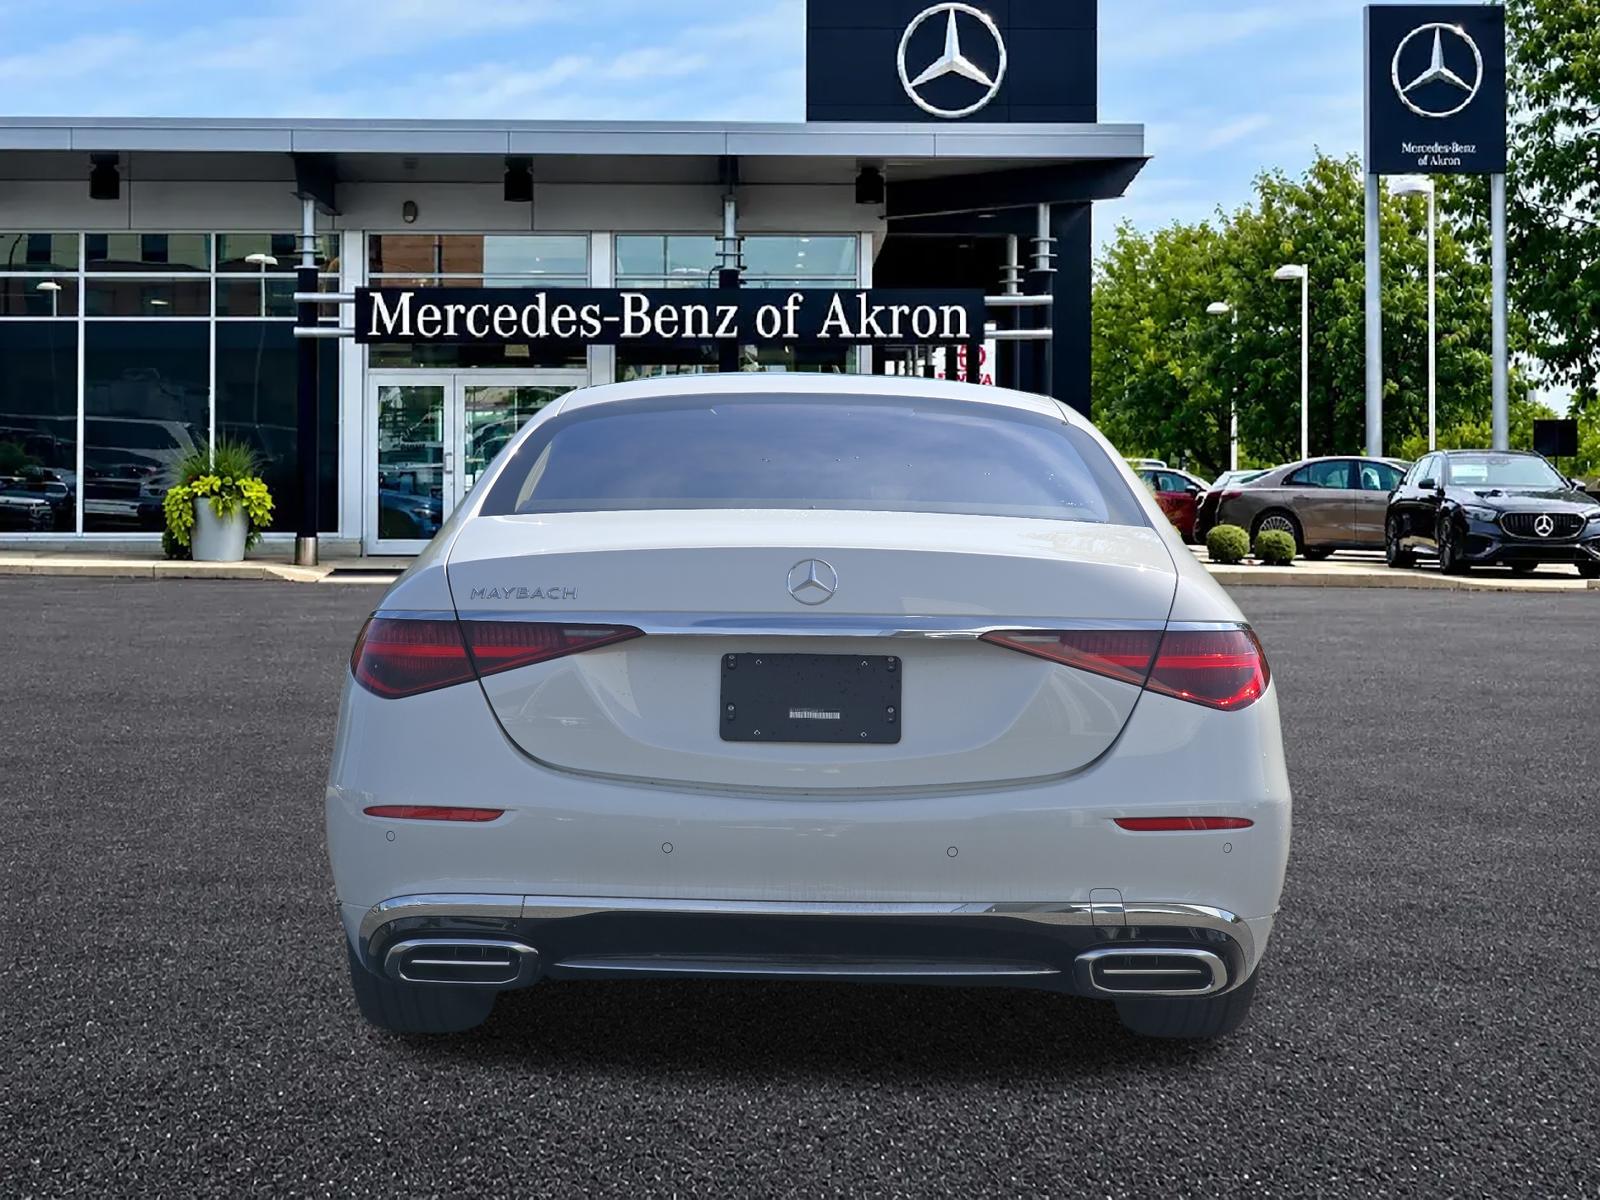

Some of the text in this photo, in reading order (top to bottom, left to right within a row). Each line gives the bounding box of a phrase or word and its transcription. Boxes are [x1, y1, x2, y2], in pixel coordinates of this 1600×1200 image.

[1401, 141, 1476, 153] Mercedes-Benz
[1417, 154, 1461, 166] of Akron
[367, 291, 970, 339] Mercedes-Benz of Akron
[470, 586, 578, 600] MAYBACH
